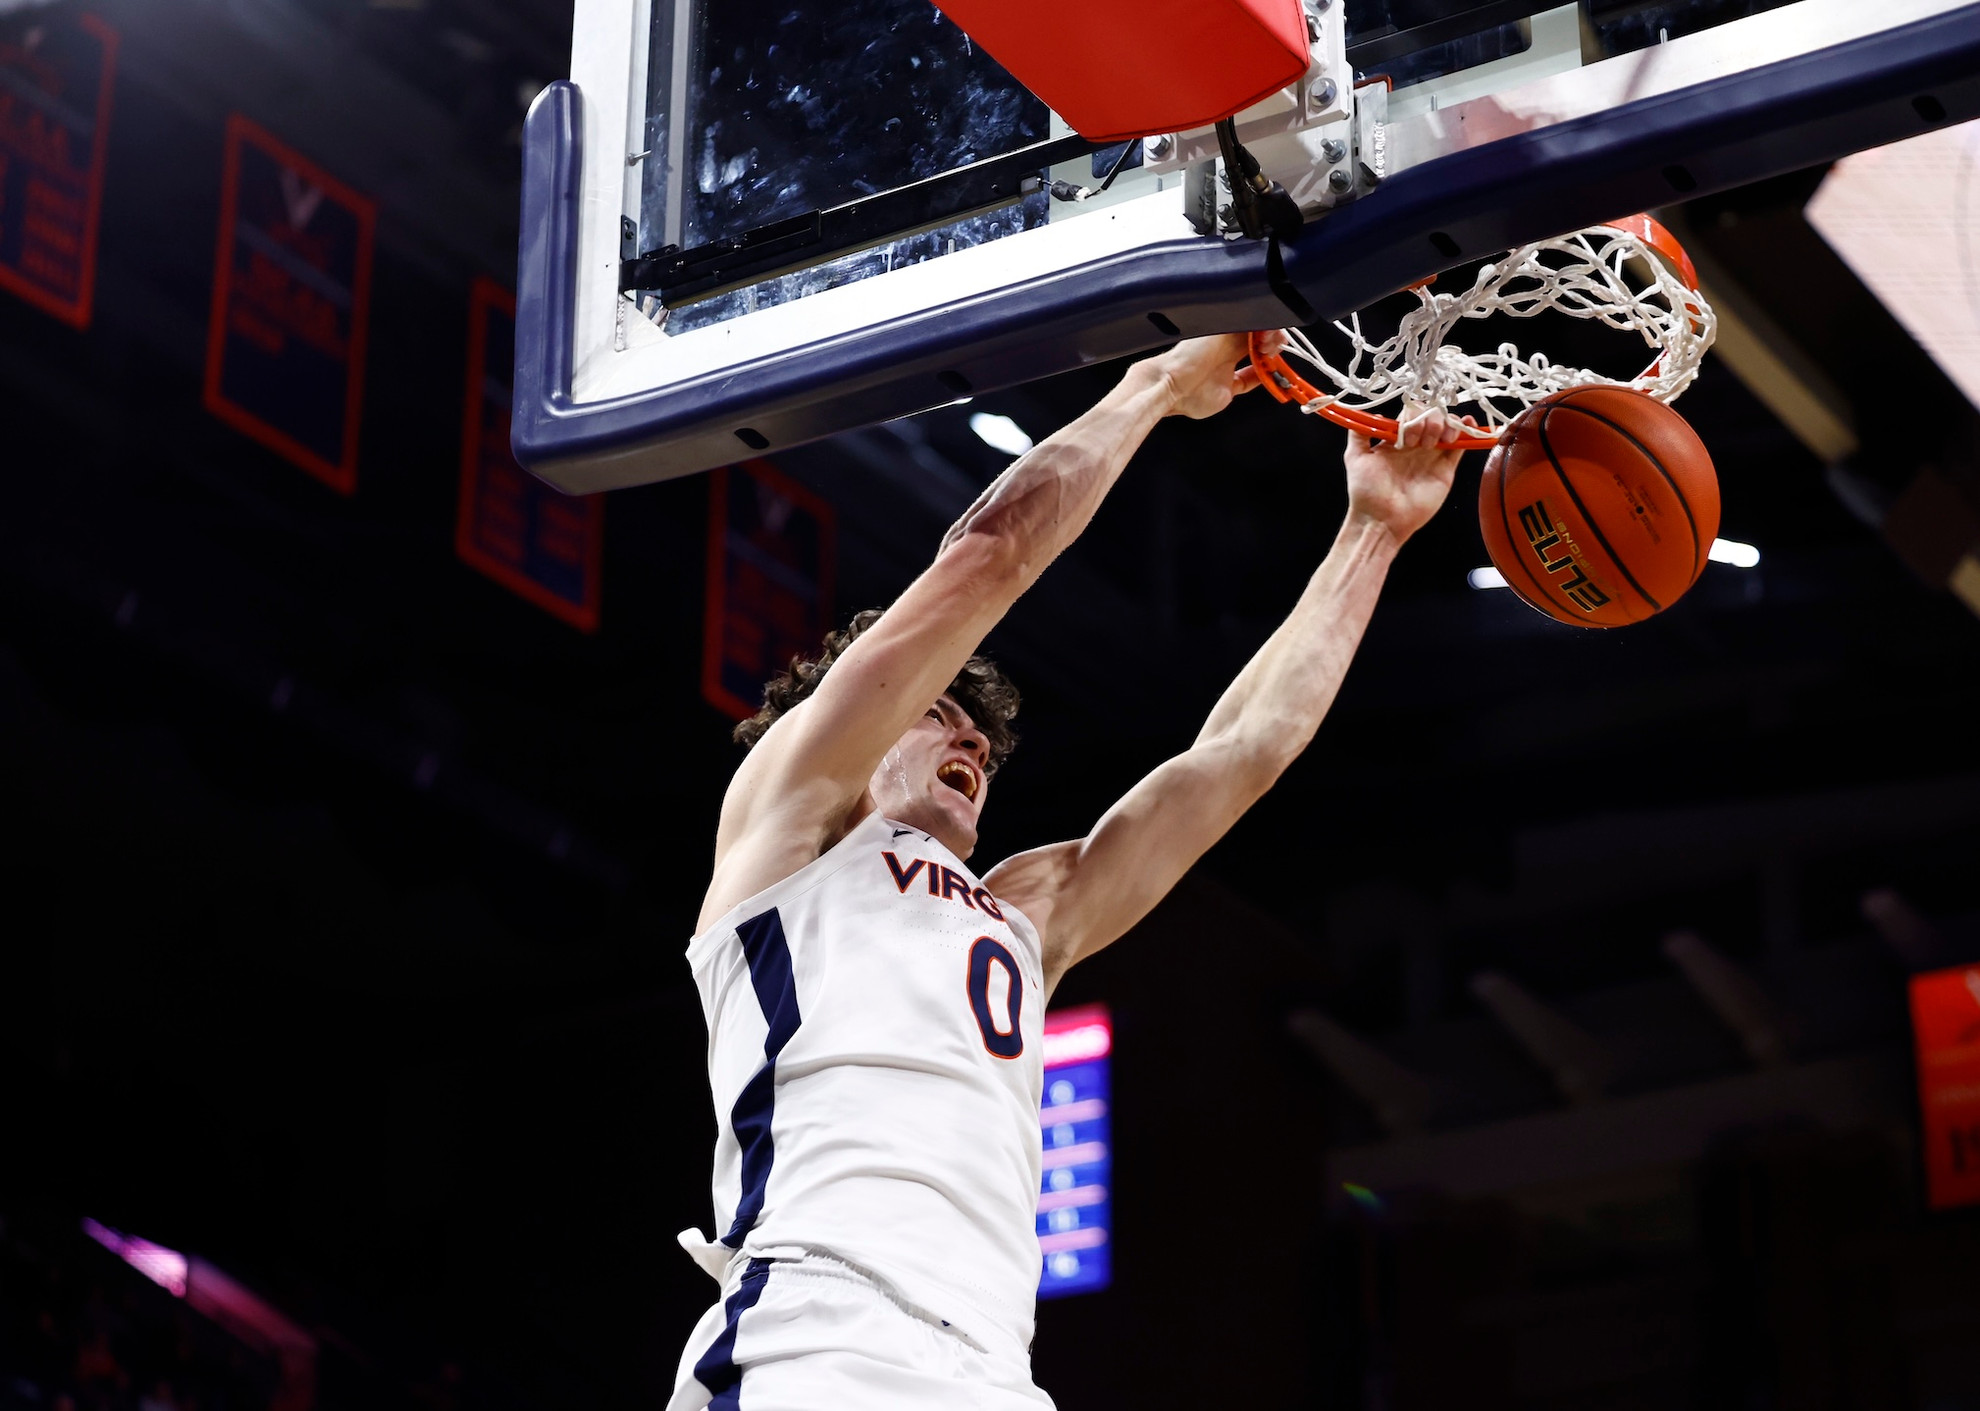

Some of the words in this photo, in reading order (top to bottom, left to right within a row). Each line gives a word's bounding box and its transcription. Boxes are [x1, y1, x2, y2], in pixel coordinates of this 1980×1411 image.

[1518, 500, 1611, 612] ELITE
[881, 851, 1006, 922] VIRG
[966, 935, 1024, 1060] 0
